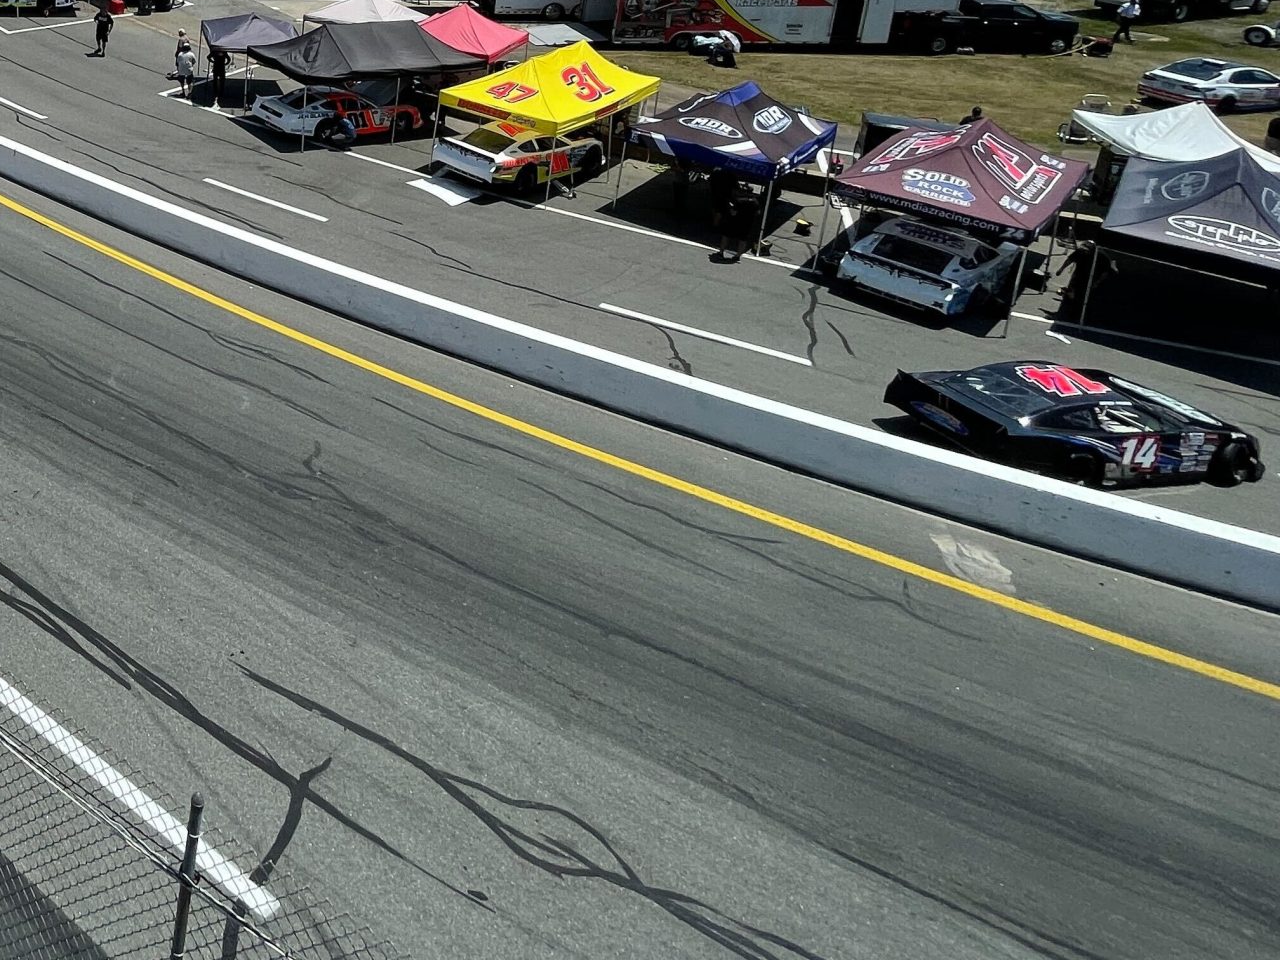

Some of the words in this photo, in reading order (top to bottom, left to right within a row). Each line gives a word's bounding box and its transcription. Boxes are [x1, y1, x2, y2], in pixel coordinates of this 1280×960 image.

[486, 81, 539, 103] 47
[561, 62, 615, 102] 31
[690, 118, 734, 134] MDR
[902, 168, 971, 188] SOLID
[917, 181, 965, 198] ROCK
[870, 192, 1000, 232] www.mdiazracing.com
[1015, 365, 1113, 398] 14
[1121, 436, 1159, 469] 14
